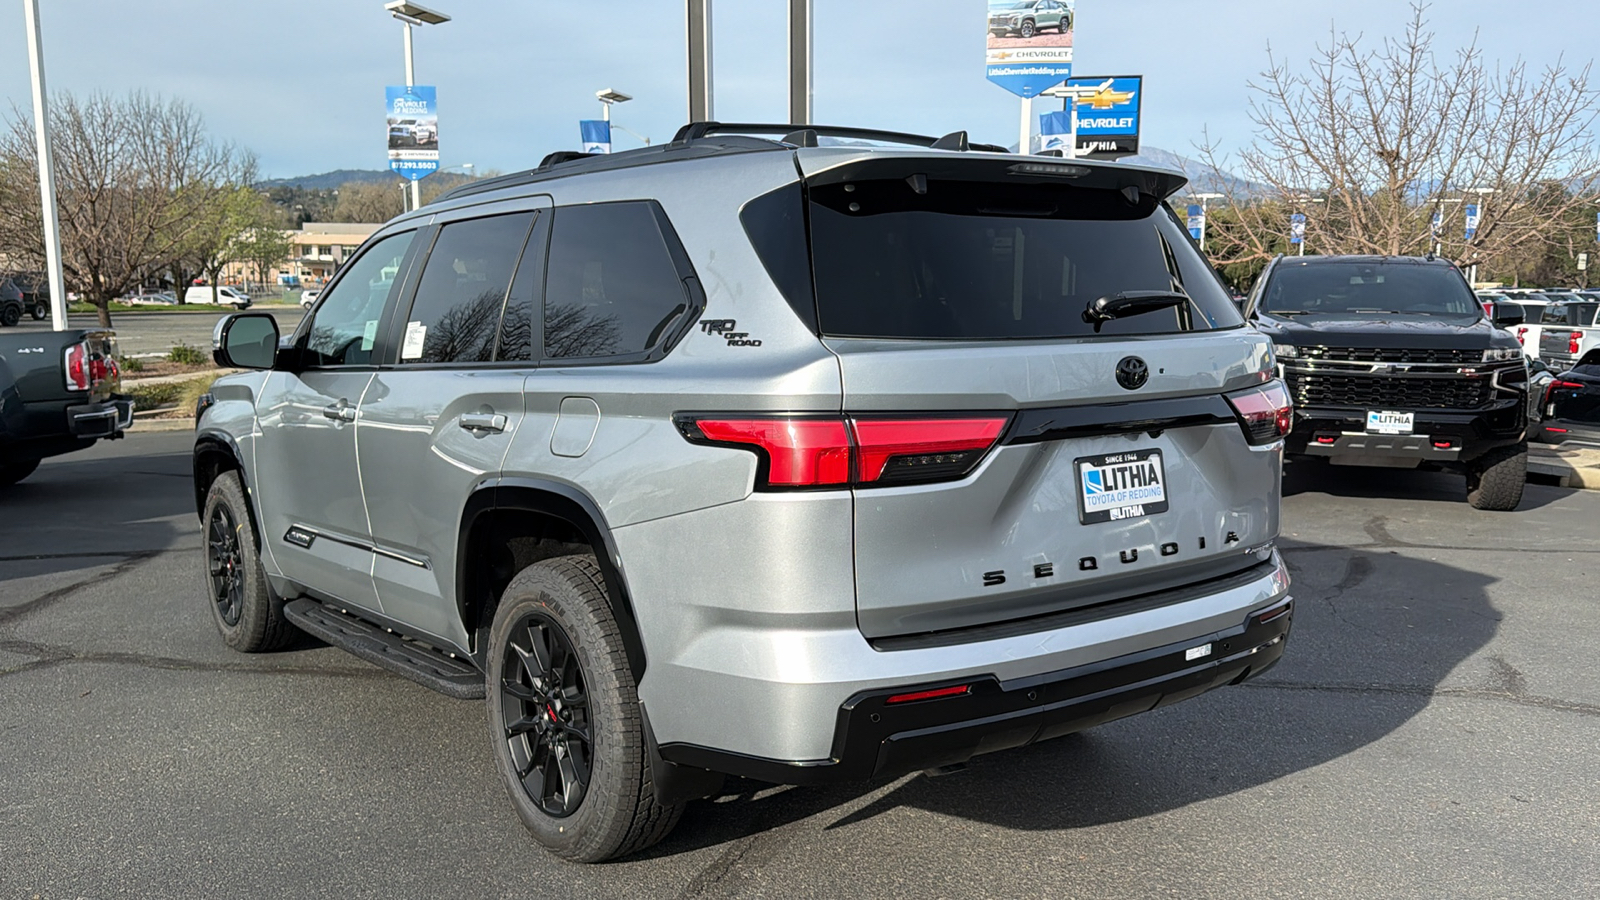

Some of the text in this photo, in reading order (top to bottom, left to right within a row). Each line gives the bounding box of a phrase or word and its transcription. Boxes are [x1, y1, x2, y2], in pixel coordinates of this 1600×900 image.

[988, 67, 1069, 76] LithiaChevroletRedding.com
[1076, 118, 1134, 129] HEVROLET
[1083, 141, 1117, 151] LITHIA
[699, 319, 736, 336] TRD
[1379, 415, 1411, 424] LITHIA
[1105, 455, 1123, 464] SINCE
[1101, 463, 1160, 492] LITHIA
[1086, 487, 1162, 506] TOYOTA OF REDDING
[1119, 504, 1145, 518] LITHIA
[982, 531, 1239, 586] SEQUOIA
